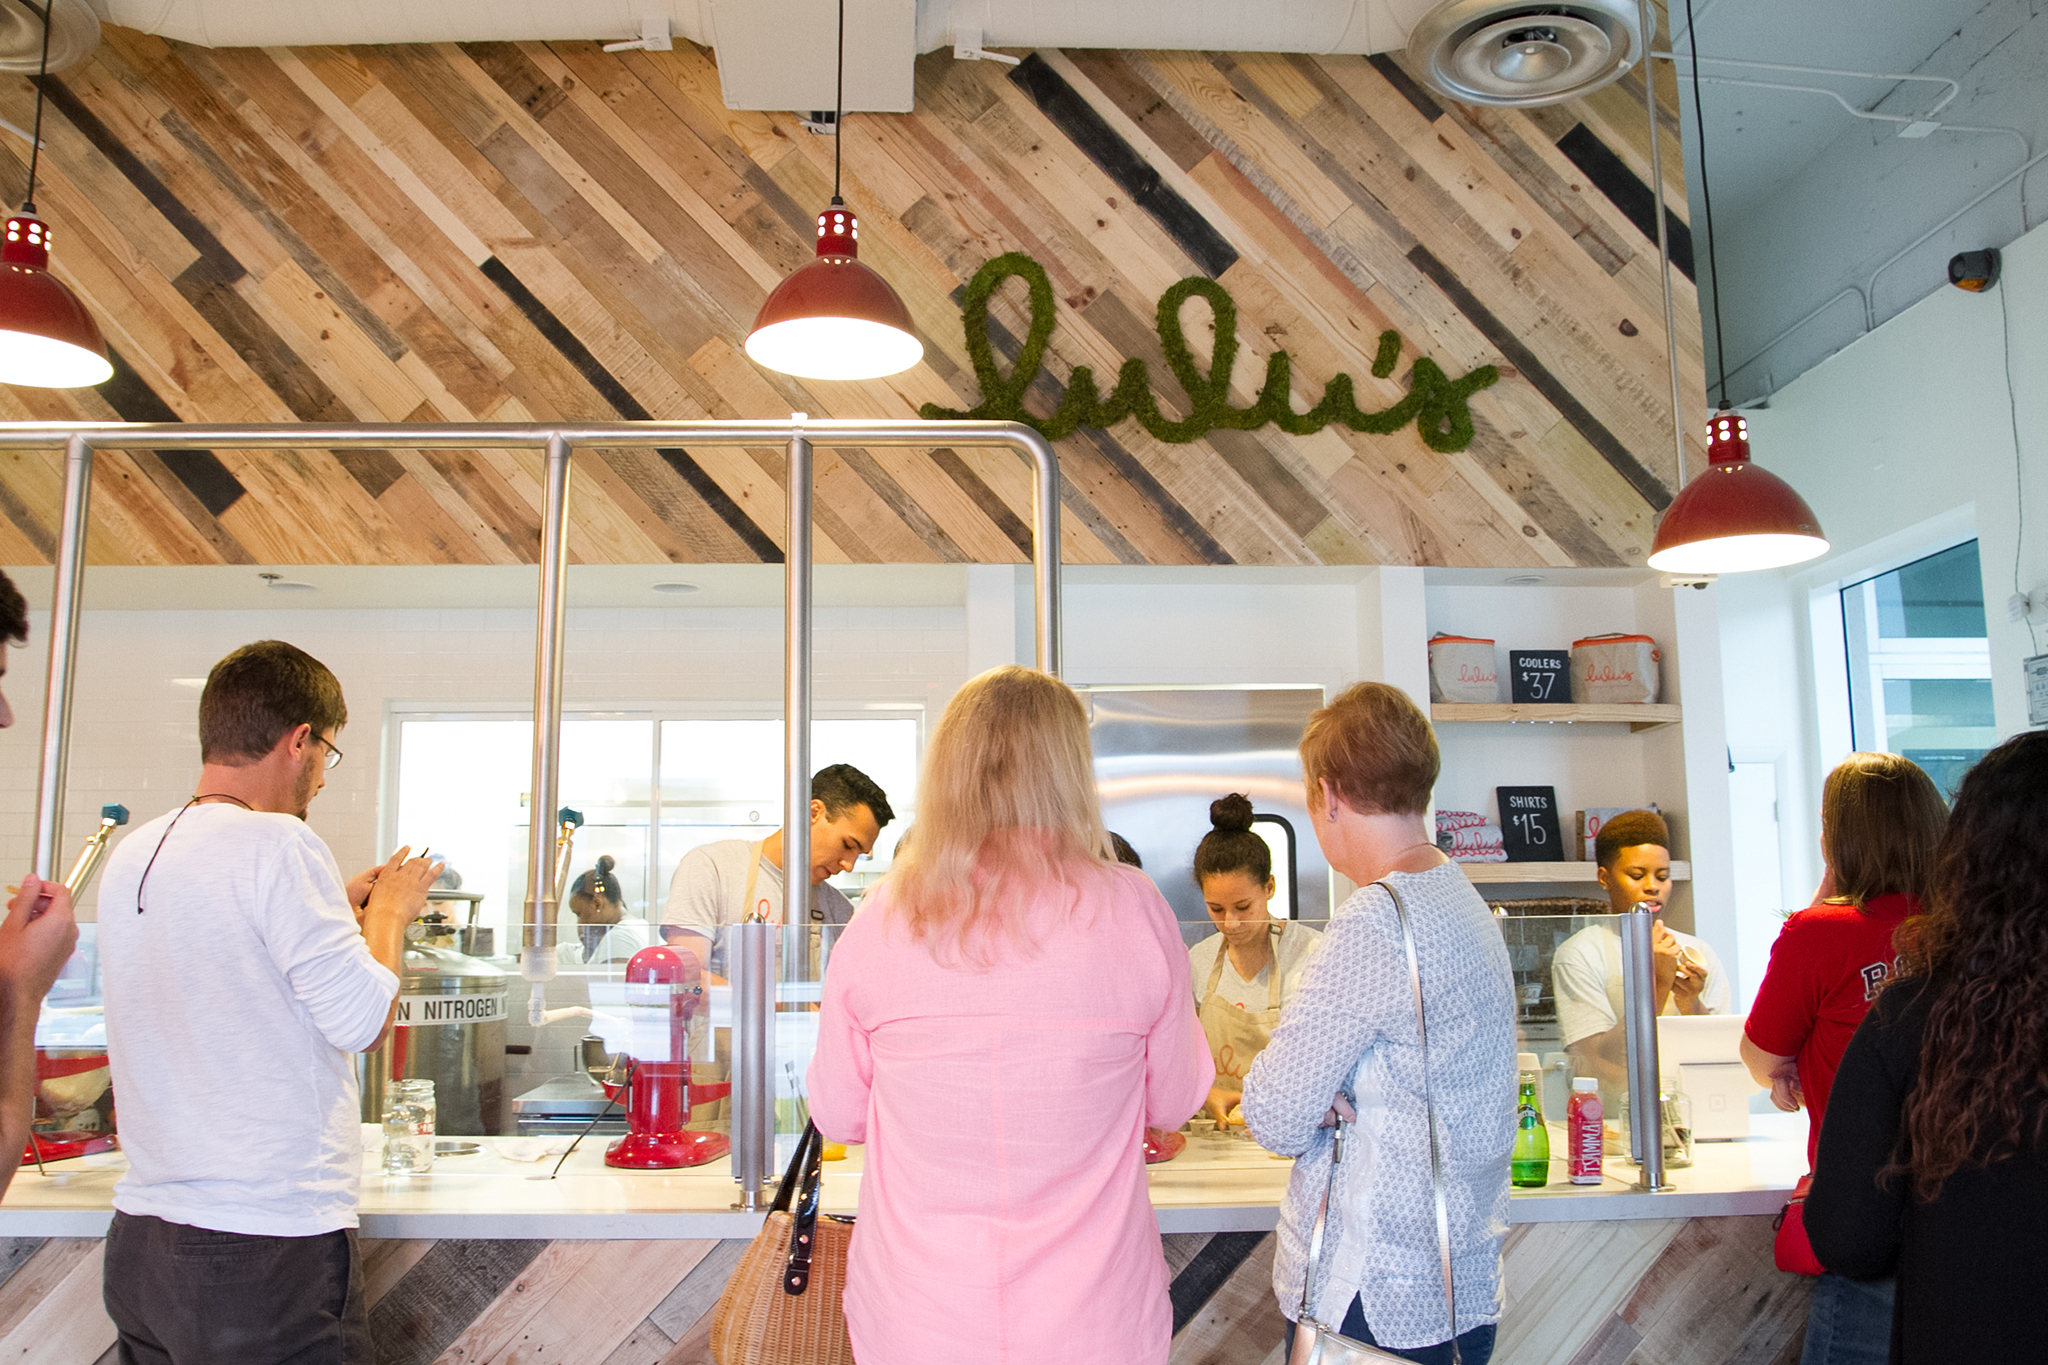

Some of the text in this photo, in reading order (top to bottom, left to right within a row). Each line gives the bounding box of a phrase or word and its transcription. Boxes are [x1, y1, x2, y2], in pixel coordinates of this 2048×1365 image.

[920, 251, 1499, 453] lulu's
[1519, 657, 1562, 669] COOLERS
[1522, 672, 1556, 700] $37
[1509, 795, 1548, 809] SHIRTS
[1512, 813, 1547, 845] $15
[424, 997, 498, 1020] NITROGEN
[1581, 1123, 1601, 1173] TSAMMA
